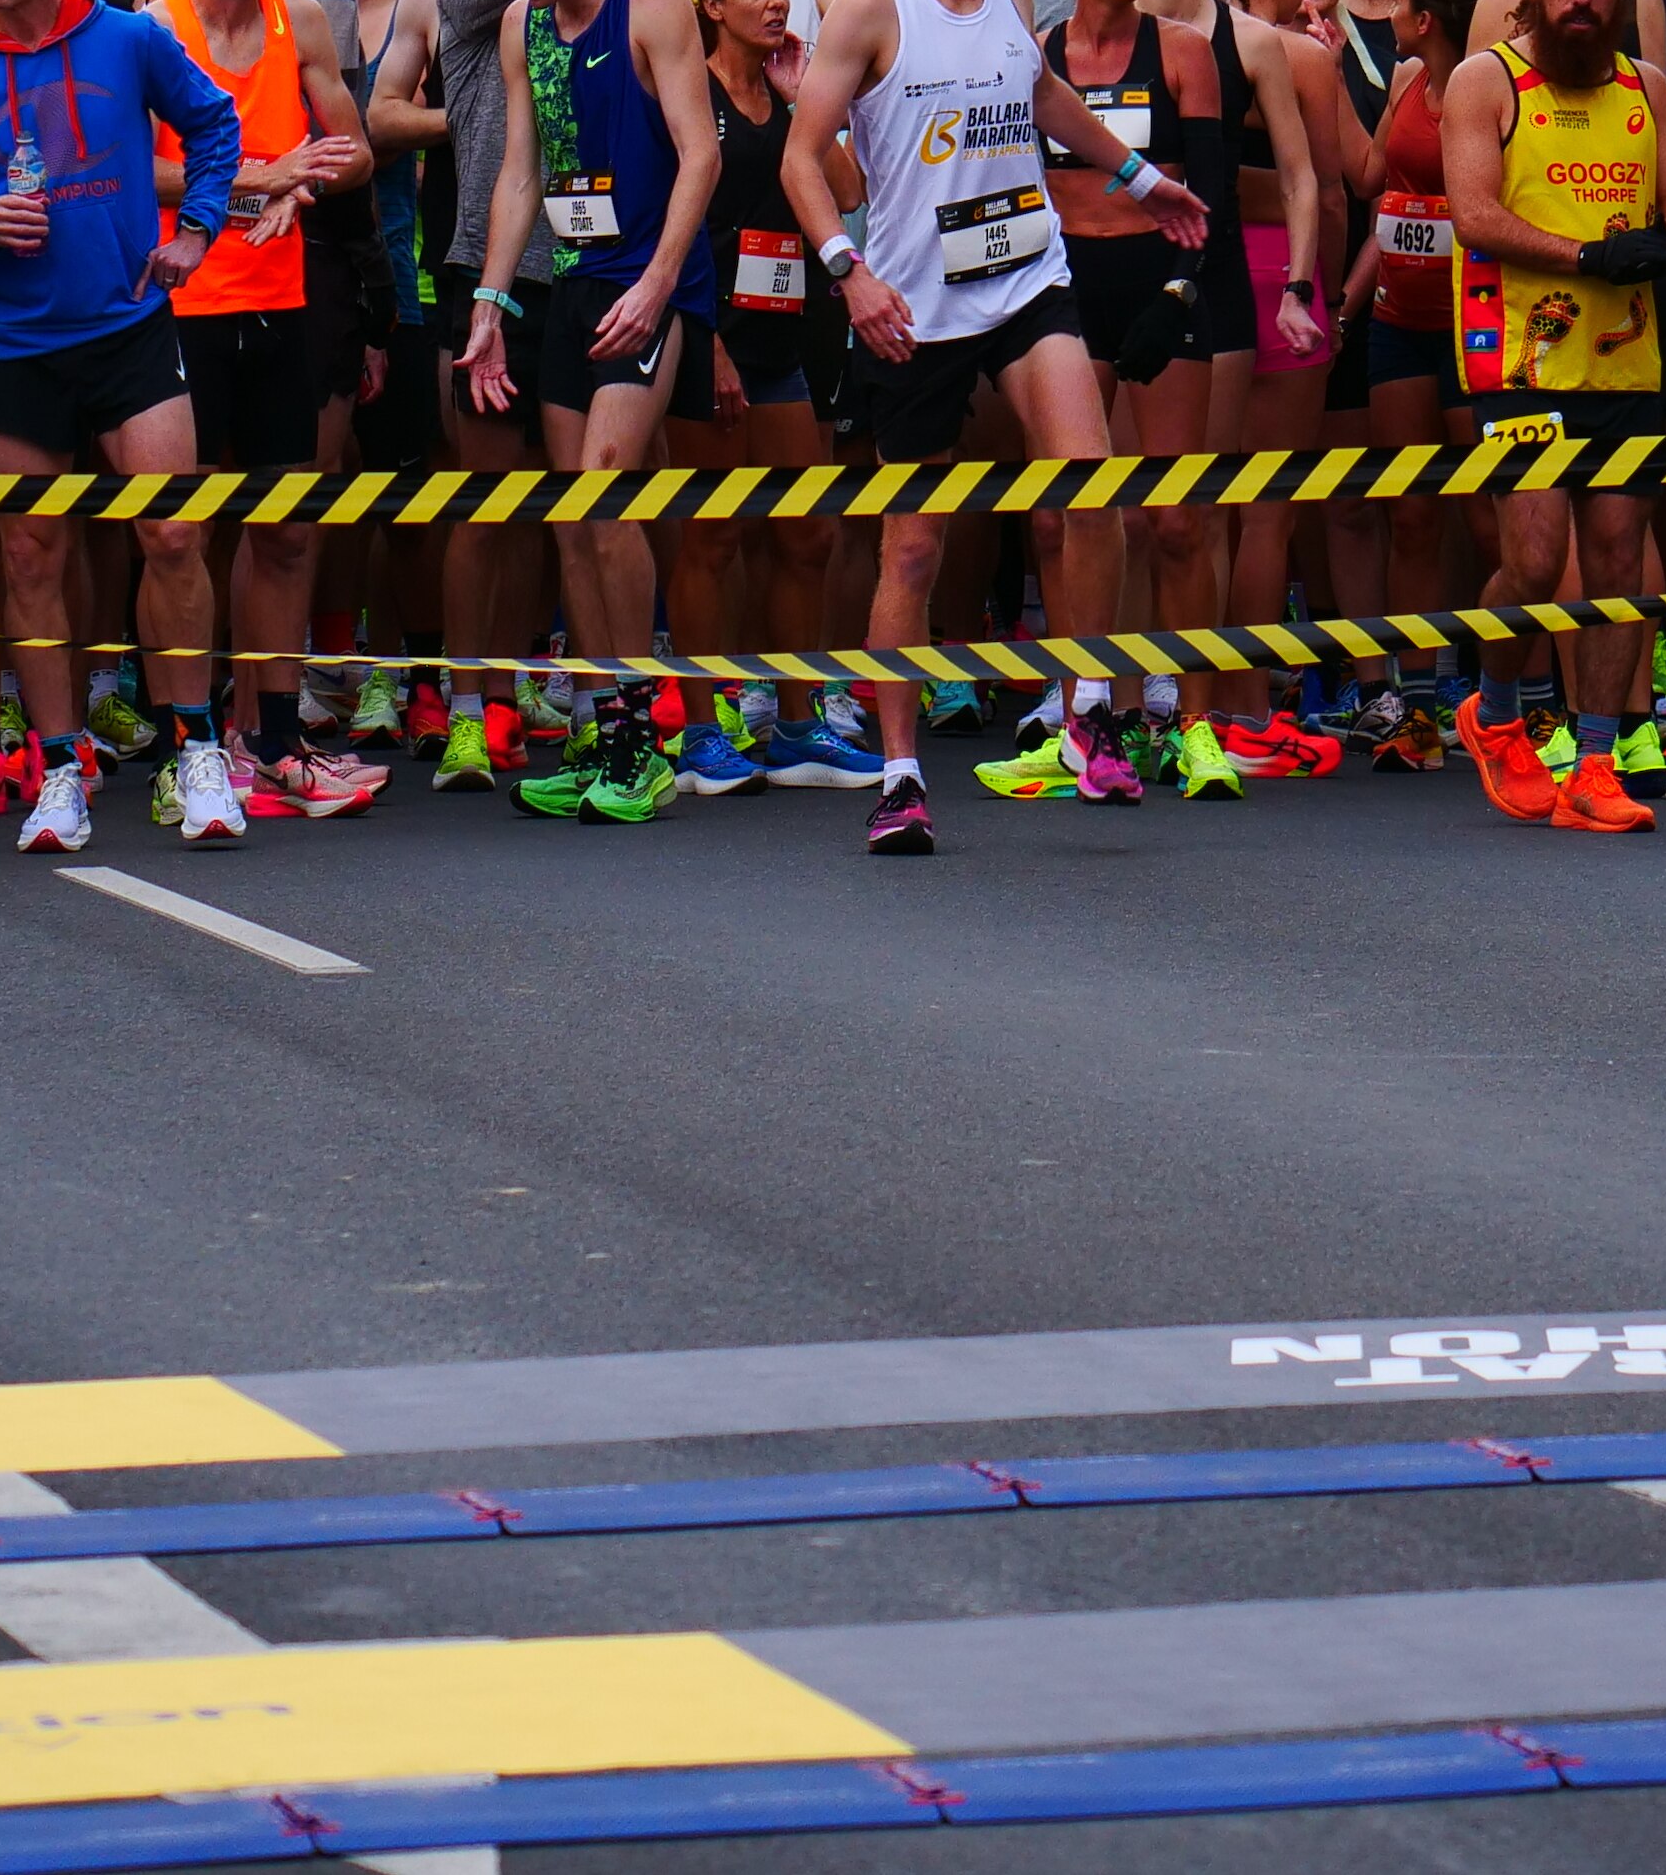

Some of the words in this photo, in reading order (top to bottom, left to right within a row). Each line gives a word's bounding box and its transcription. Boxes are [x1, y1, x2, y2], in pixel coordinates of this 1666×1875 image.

[921, 78, 958, 91] Federation
[967, 100, 1030, 127] BALLARA
[963, 123, 1033, 149] MARATHO
[1546, 162, 1647, 185] GOOGZY
[226, 195, 263, 215] DANIEL
[1571, 188, 1637, 204] THORPE
[984, 224, 1008, 243] 1445
[1393, 221, 1435, 253] 4692
[985, 240, 1011, 260] AZZA
[772, 278, 790, 294] ELLA
